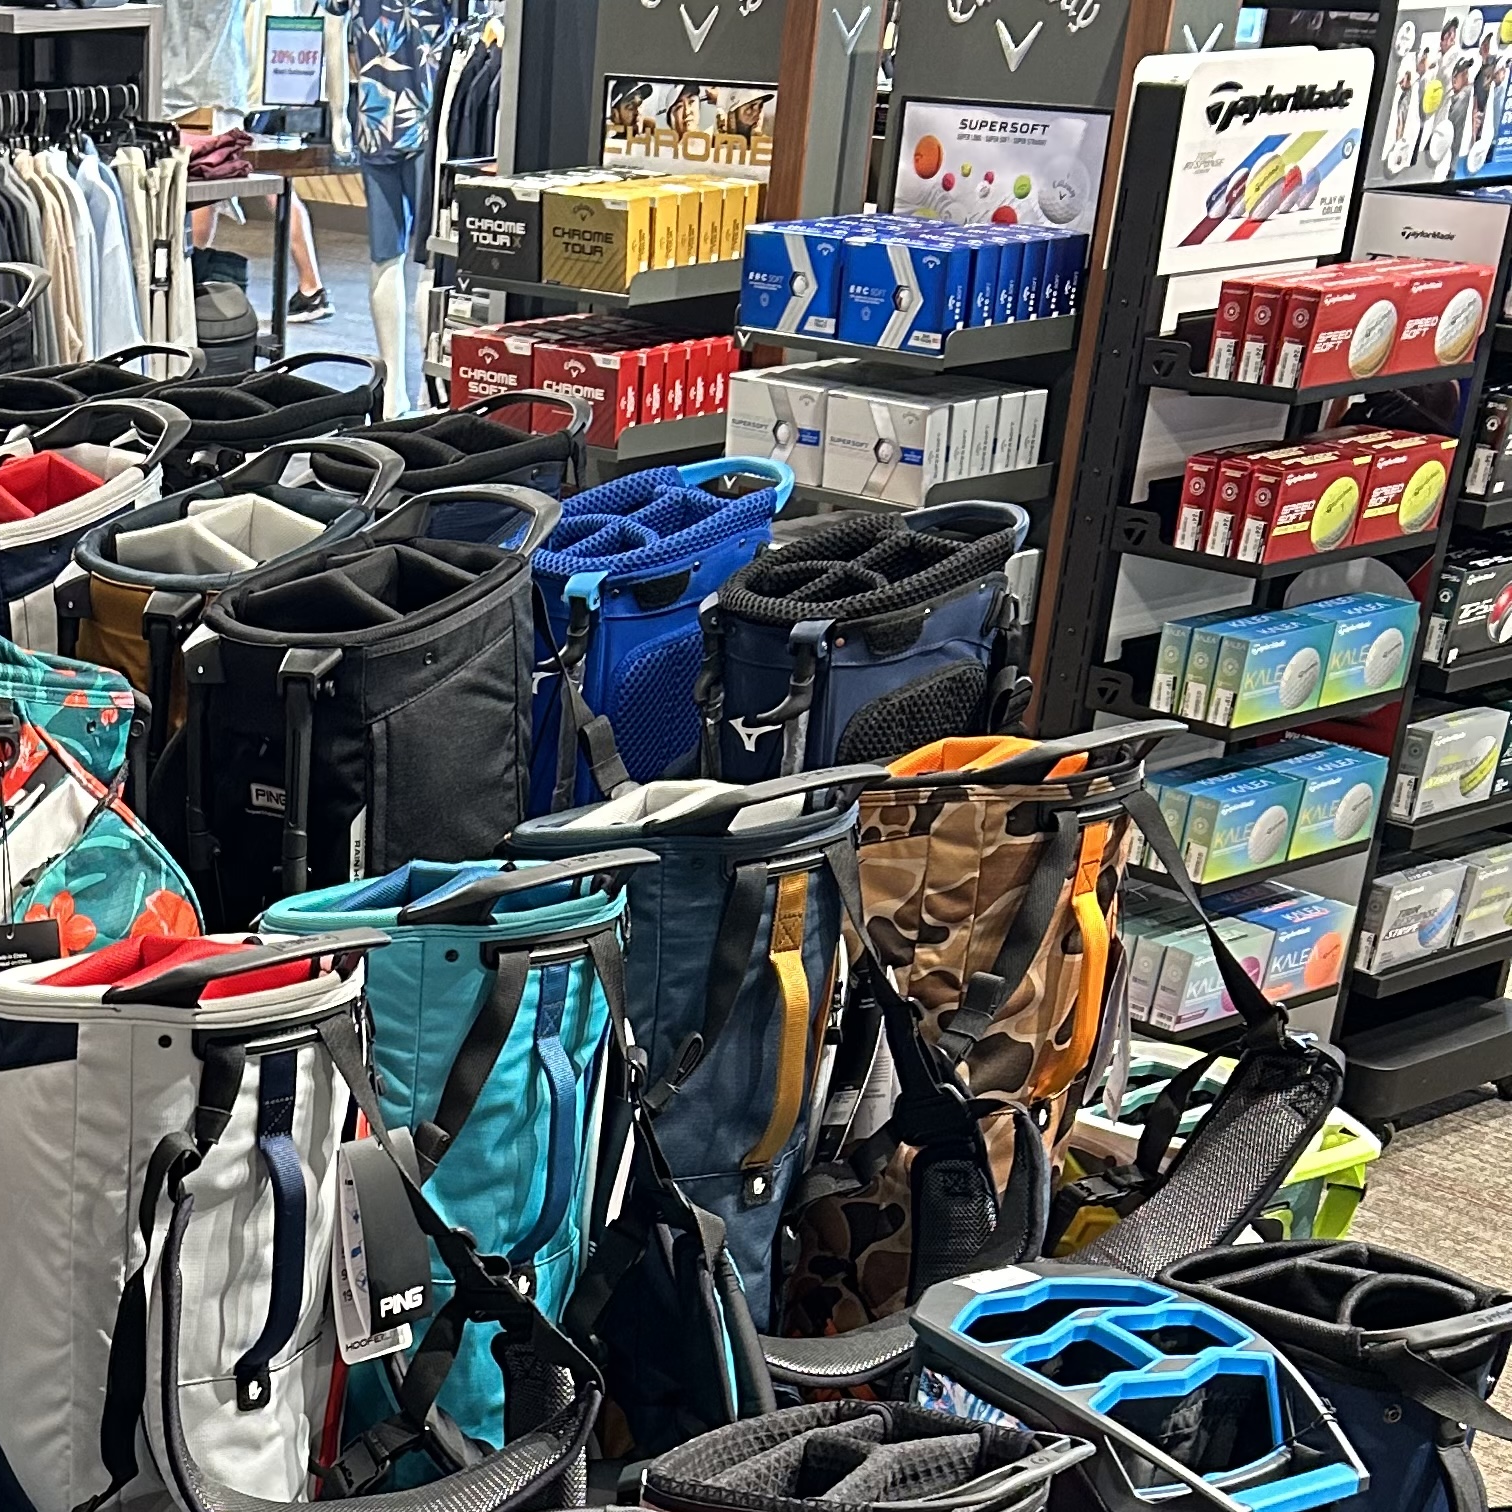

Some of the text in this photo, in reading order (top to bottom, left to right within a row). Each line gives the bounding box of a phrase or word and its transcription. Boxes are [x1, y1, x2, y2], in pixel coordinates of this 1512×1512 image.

[271, 50, 318, 64] 20% OFF
[1206, 80, 1353, 134] TaylorMade
[959, 119, 1050, 135] SUPERSOFT
[604, 124, 773, 166] CHROME
[466, 217, 526, 235] CHROME
[469, 231, 510, 246] TOUR
[552, 226, 614, 244] CHROME
[1401, 227, 1456, 241] TaylorMade
[563, 241, 604, 257] TOUR
[1405, 316, 1439, 328] SPEED
[1317, 329, 1353, 342] SPEED
[1400, 326, 1429, 341] SOFT
[1312, 339, 1343, 354] SOFT
[459, 366, 518, 386] CHROME
[468, 381, 508, 394] SOFT
[543, 380, 605, 401] CHROME
[829, 435, 869, 449] SUPERSOFT
[1372, 482, 1405, 496] SPEED
[1282, 500, 1316, 513] SPEED
[1368, 494, 1396, 507] SOFT
[1277, 511, 1307, 524] SOFT
[1316, 595, 1363, 608] KALEA
[1343, 602, 1391, 615] KALEA
[1228, 614, 1277, 628] KALEA
[1256, 621, 1306, 634] KALEA
[1330, 643, 1368, 669] KALE
[1244, 663, 1285, 690] KALE
[1312, 757, 1360, 772] KALEA
[1197, 771, 1244, 786] KALEA
[1227, 779, 1275, 795] KALEA
[1300, 801, 1338, 825] KALE
[1214, 821, 1254, 848] KALE
[1281, 905, 1323, 921] KALEA
[1187, 975, 1225, 998] KALE
[380, 1285, 424, 1318] PING
